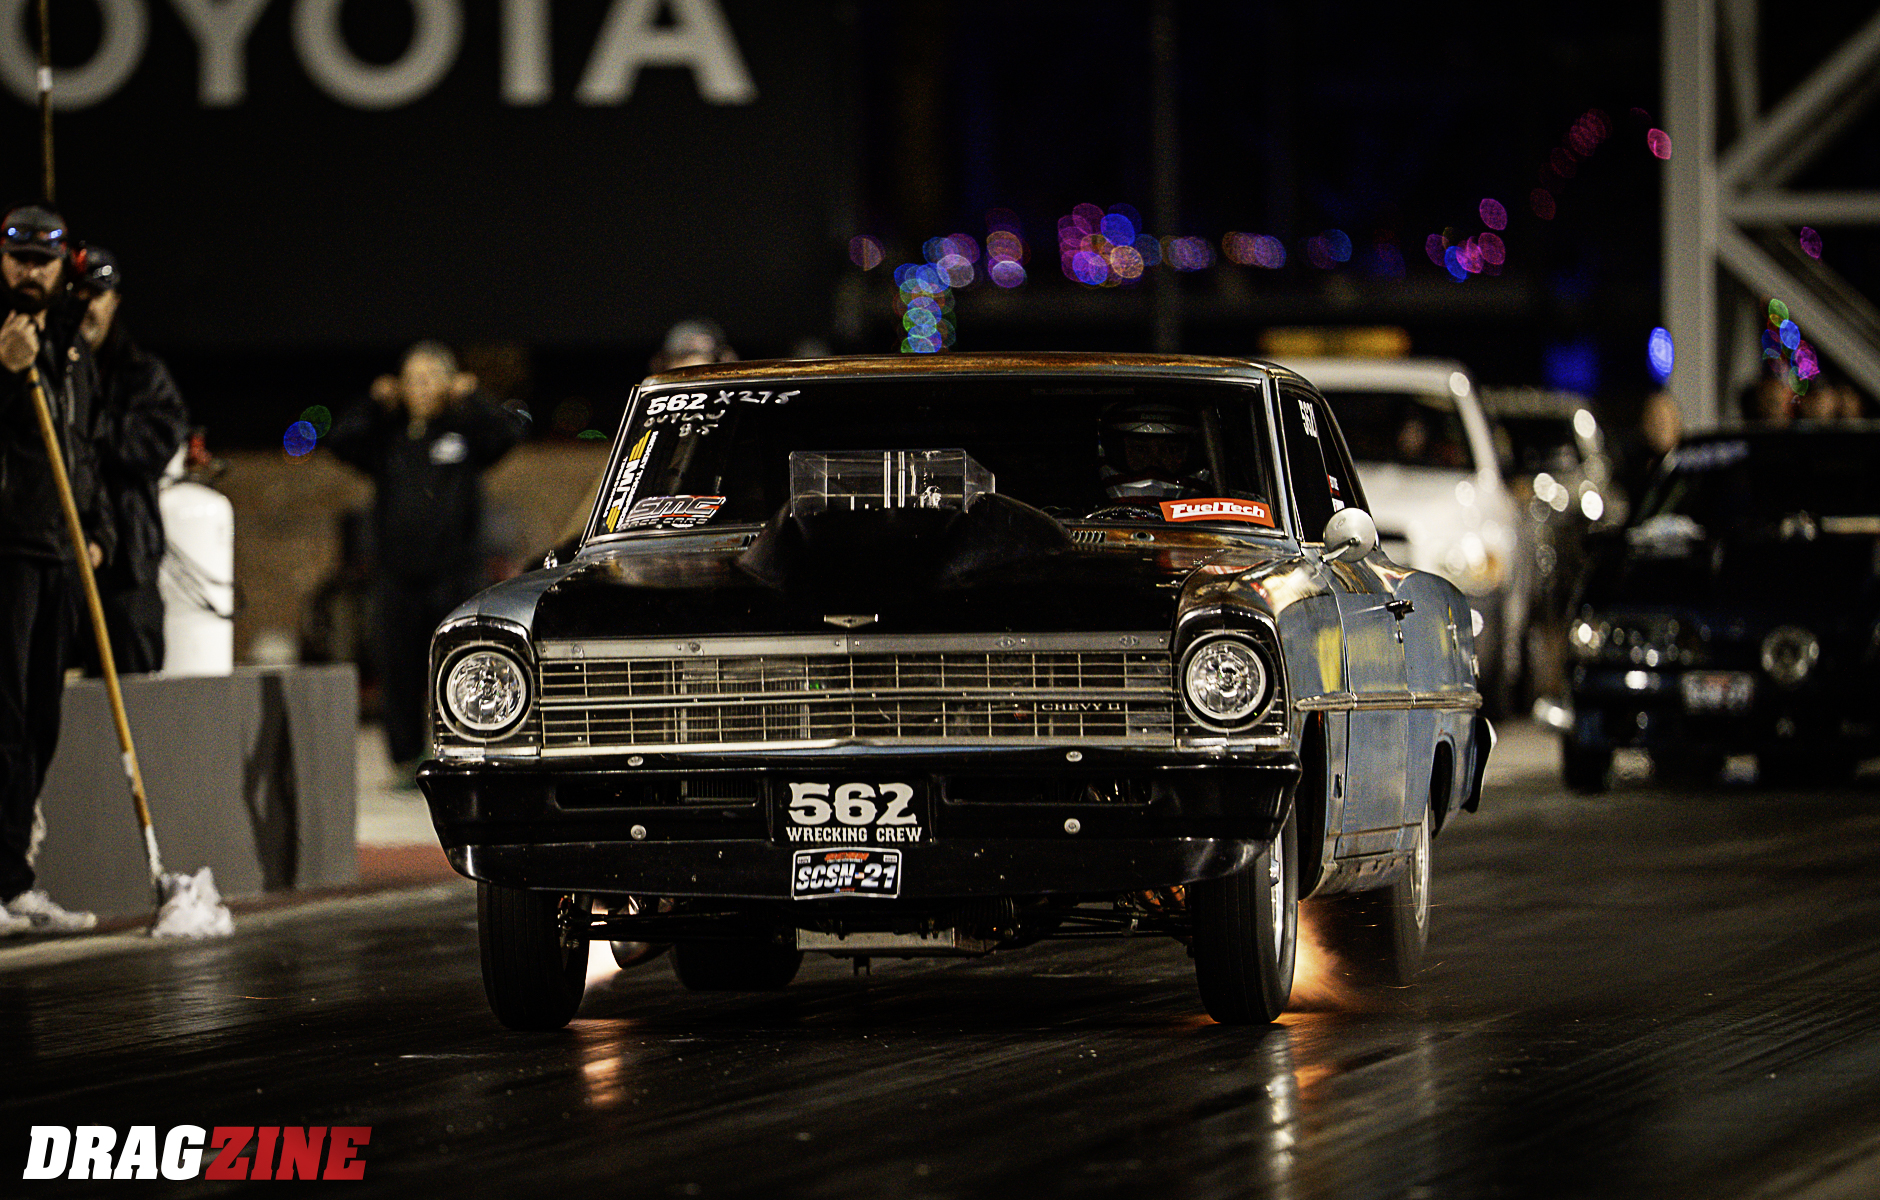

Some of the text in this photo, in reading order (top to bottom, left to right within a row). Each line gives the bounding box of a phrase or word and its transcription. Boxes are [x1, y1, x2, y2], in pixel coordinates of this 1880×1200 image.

[646, 393, 708, 415] 562
[1169, 502, 1265, 519] FuelTech
[1041, 702, 1103, 711] CHEVY
[788, 782, 918, 825] 562
[786, 826, 922, 842] WRECKING CREW
